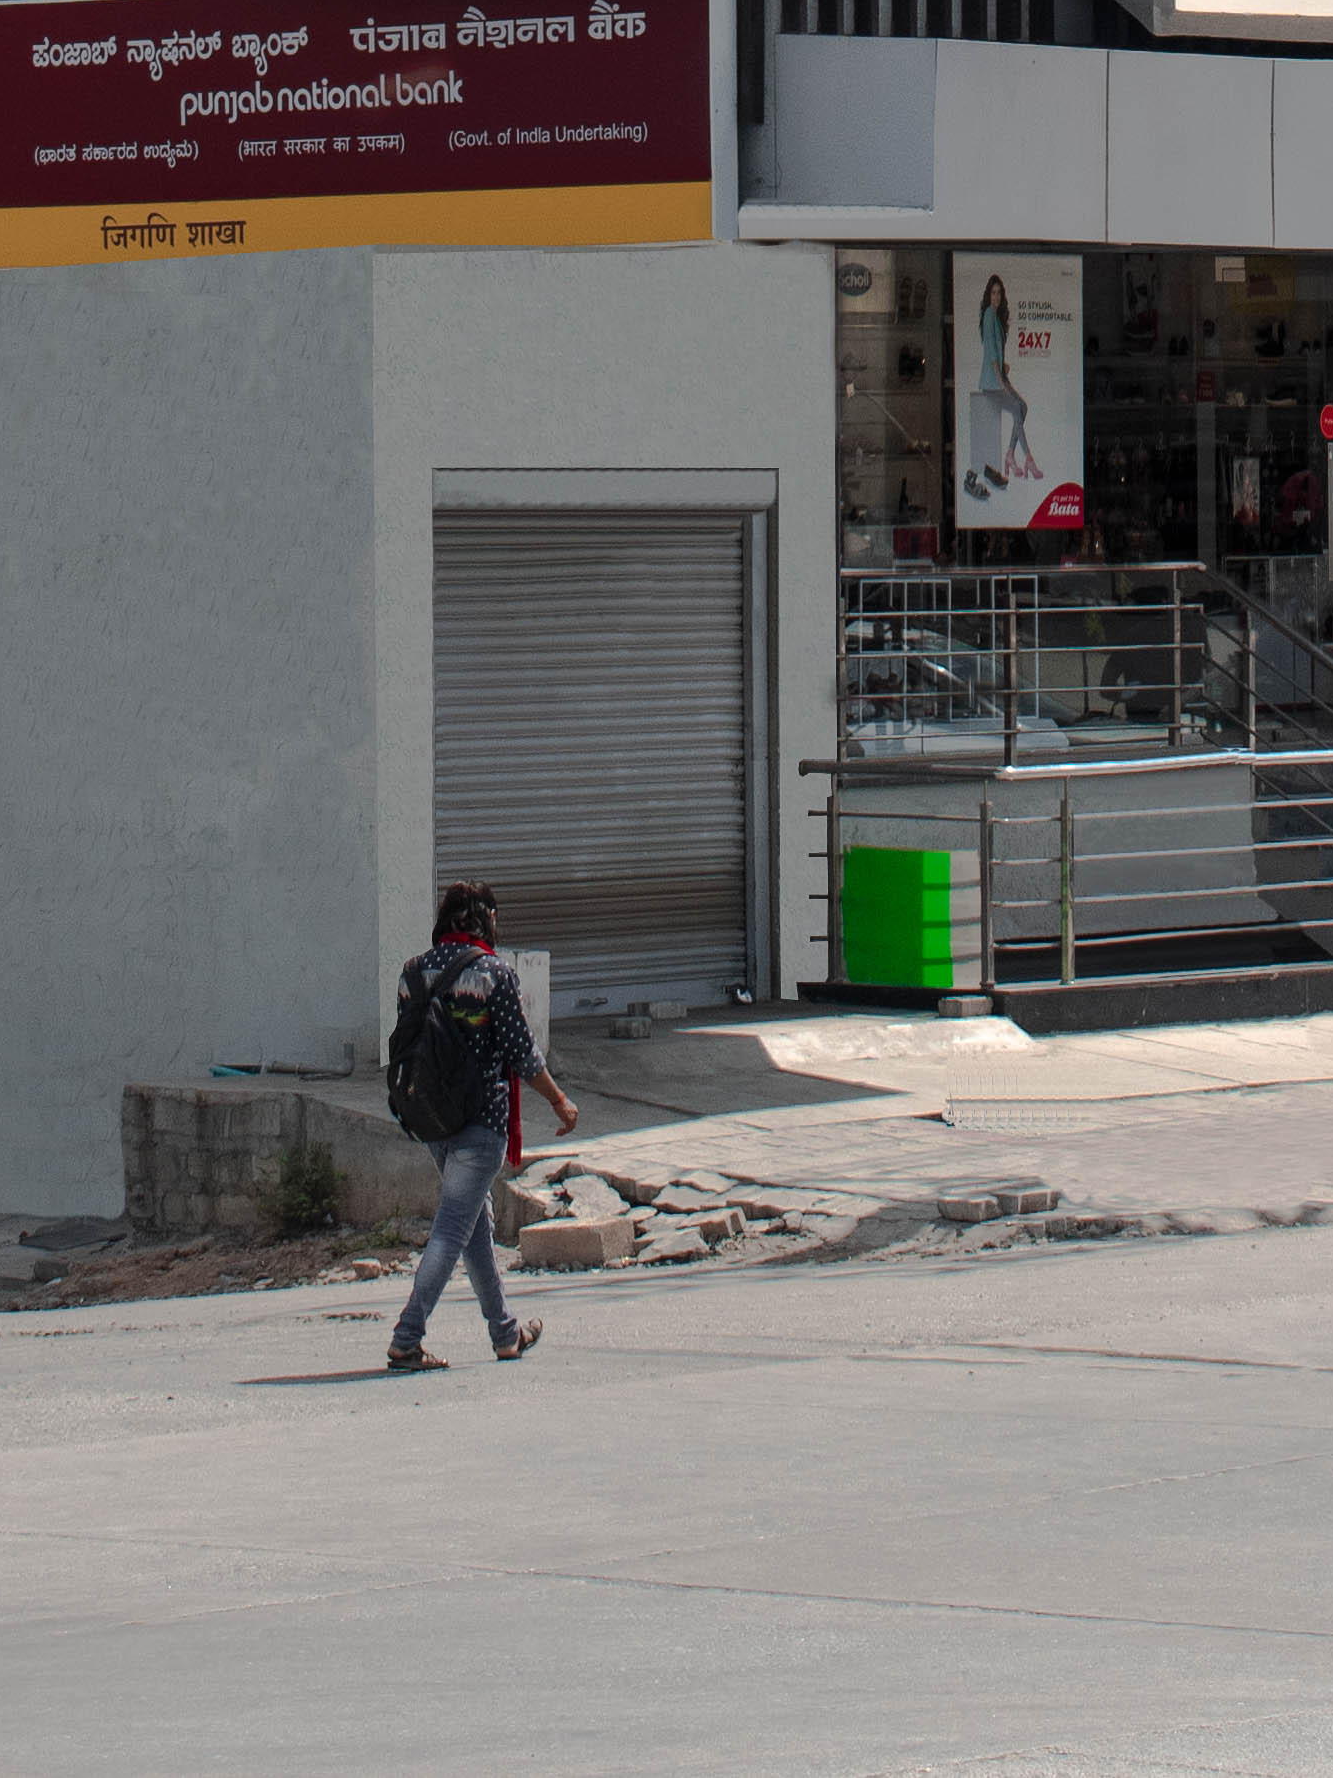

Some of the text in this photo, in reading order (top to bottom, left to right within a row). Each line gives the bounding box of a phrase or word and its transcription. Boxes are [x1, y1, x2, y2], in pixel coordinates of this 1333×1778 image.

[348, 17, 446, 53] पंजाब
[455, 5, 576, 49] नैशनल
[32, 25, 308, 82] ಪಂಜಾಬ್ ನ್ಯಾಷನಲ್ ಬ್ಯಾಂಕ್
[179, 69, 464, 126] punjab national bank
[238, 139, 278, 162] (भारत
[282, 137, 327, 158] सरकार
[333, 135, 351, 154] का
[448, 121, 648, 152] (Govt. of India Undertaking)
[101, 212, 246, 250] जिगणि शाखा
[1018, 331, 1052, 350] 24X7
[1047, 501, 1079, 516] Bata
